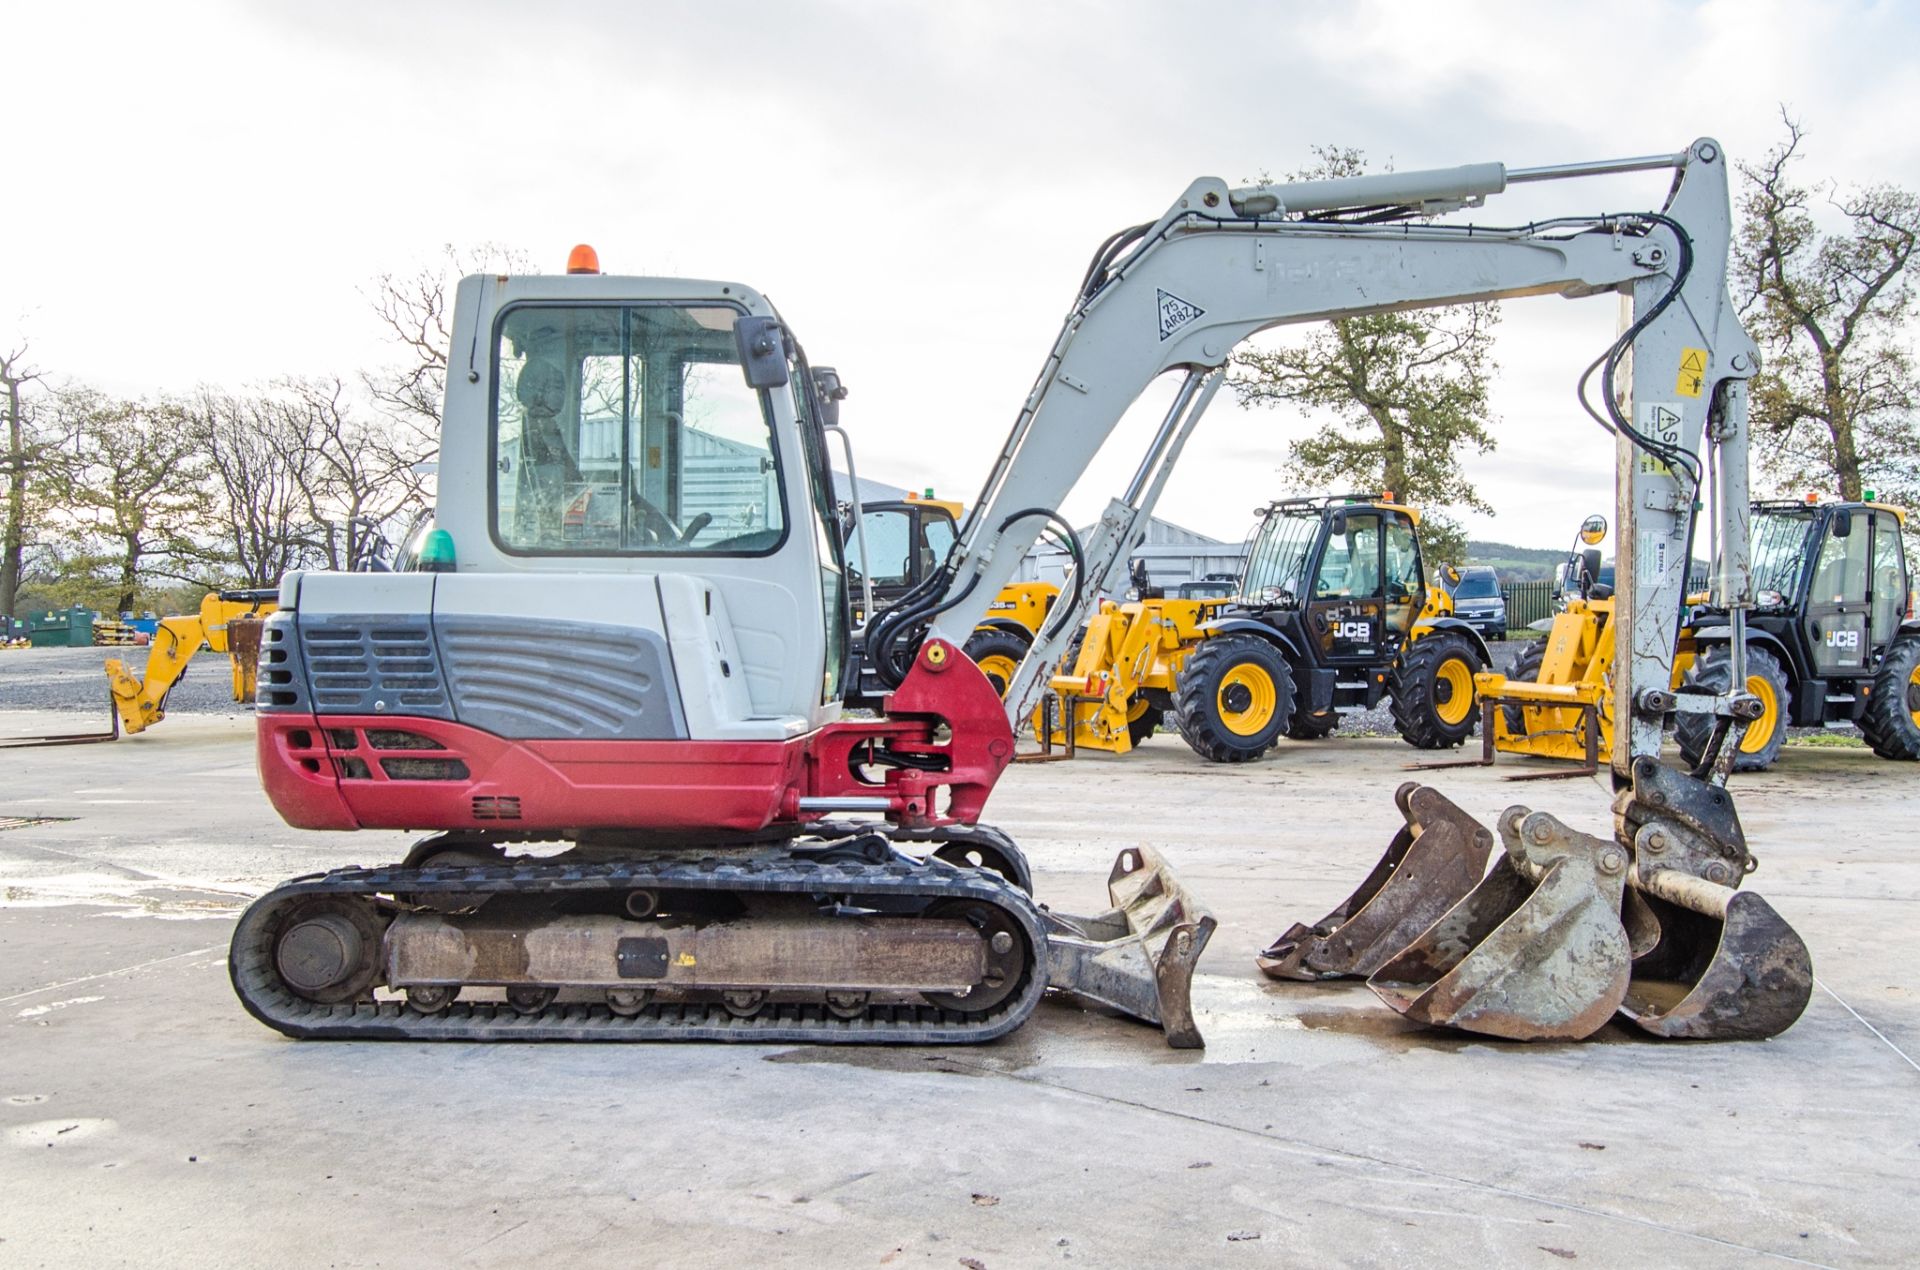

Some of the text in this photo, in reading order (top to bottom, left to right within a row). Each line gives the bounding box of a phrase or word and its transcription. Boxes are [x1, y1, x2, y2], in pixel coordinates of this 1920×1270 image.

[1162, 300, 1179, 315] 75
[1333, 622, 1370, 638] JCB
[1826, 630, 1858, 647] JCB
